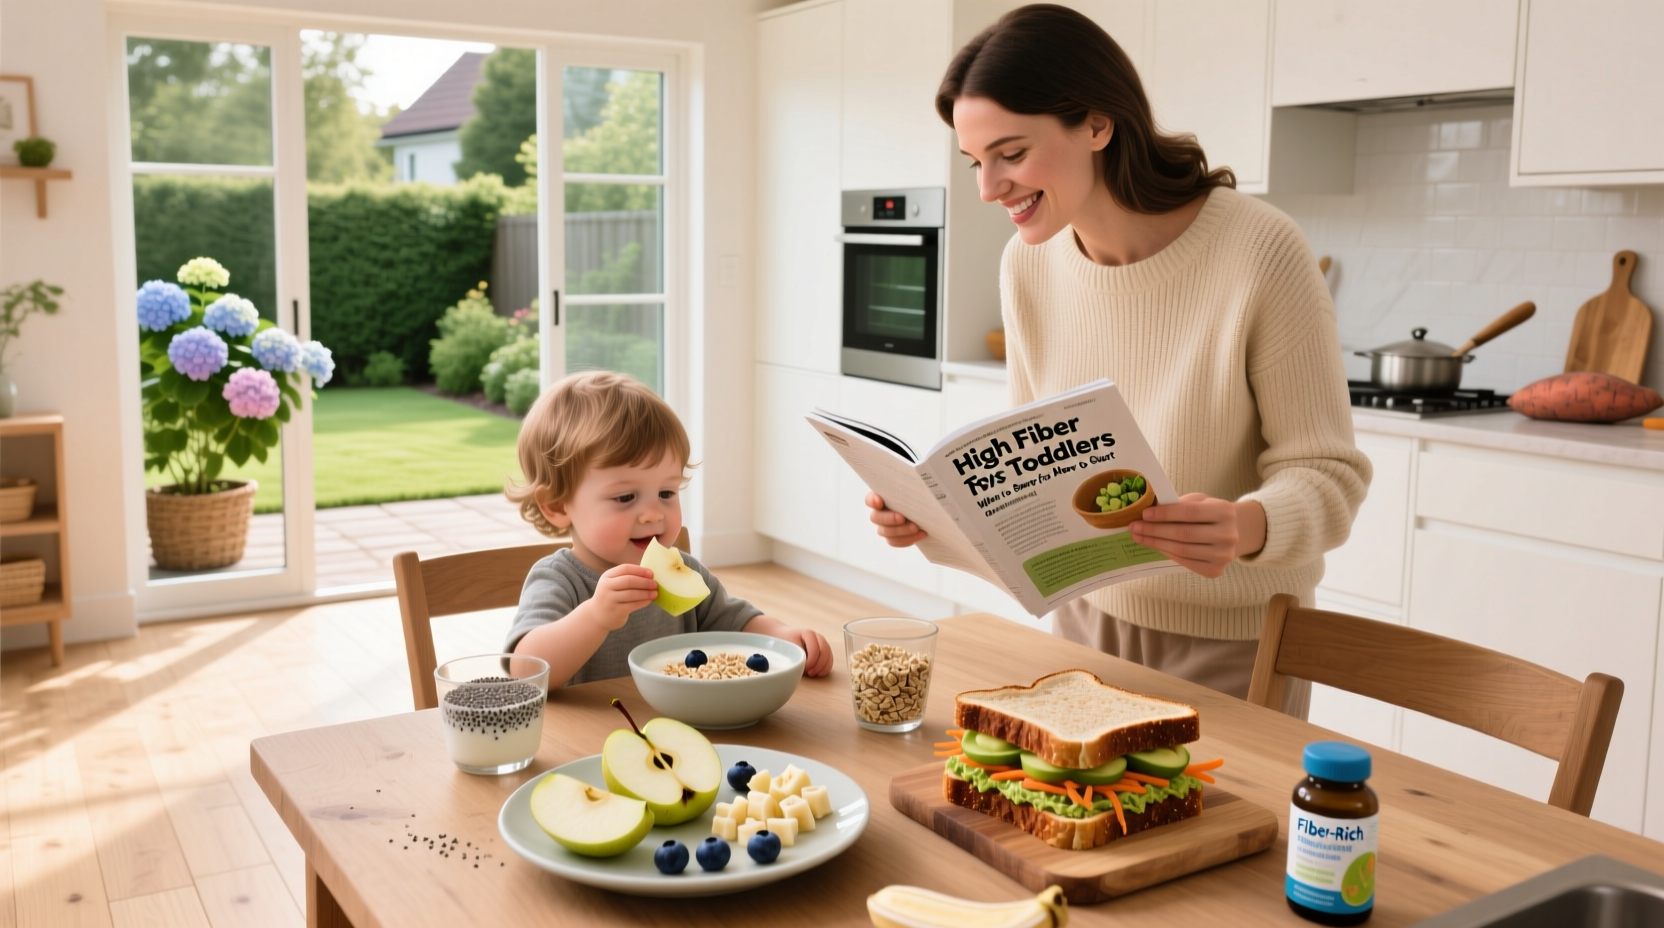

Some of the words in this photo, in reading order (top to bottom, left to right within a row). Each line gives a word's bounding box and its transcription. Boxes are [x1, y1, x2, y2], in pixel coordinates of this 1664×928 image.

[952, 438, 1013, 475] High
[1012, 417, 1079, 449] Fiber
[1004, 432, 1116, 476] Toddlers
